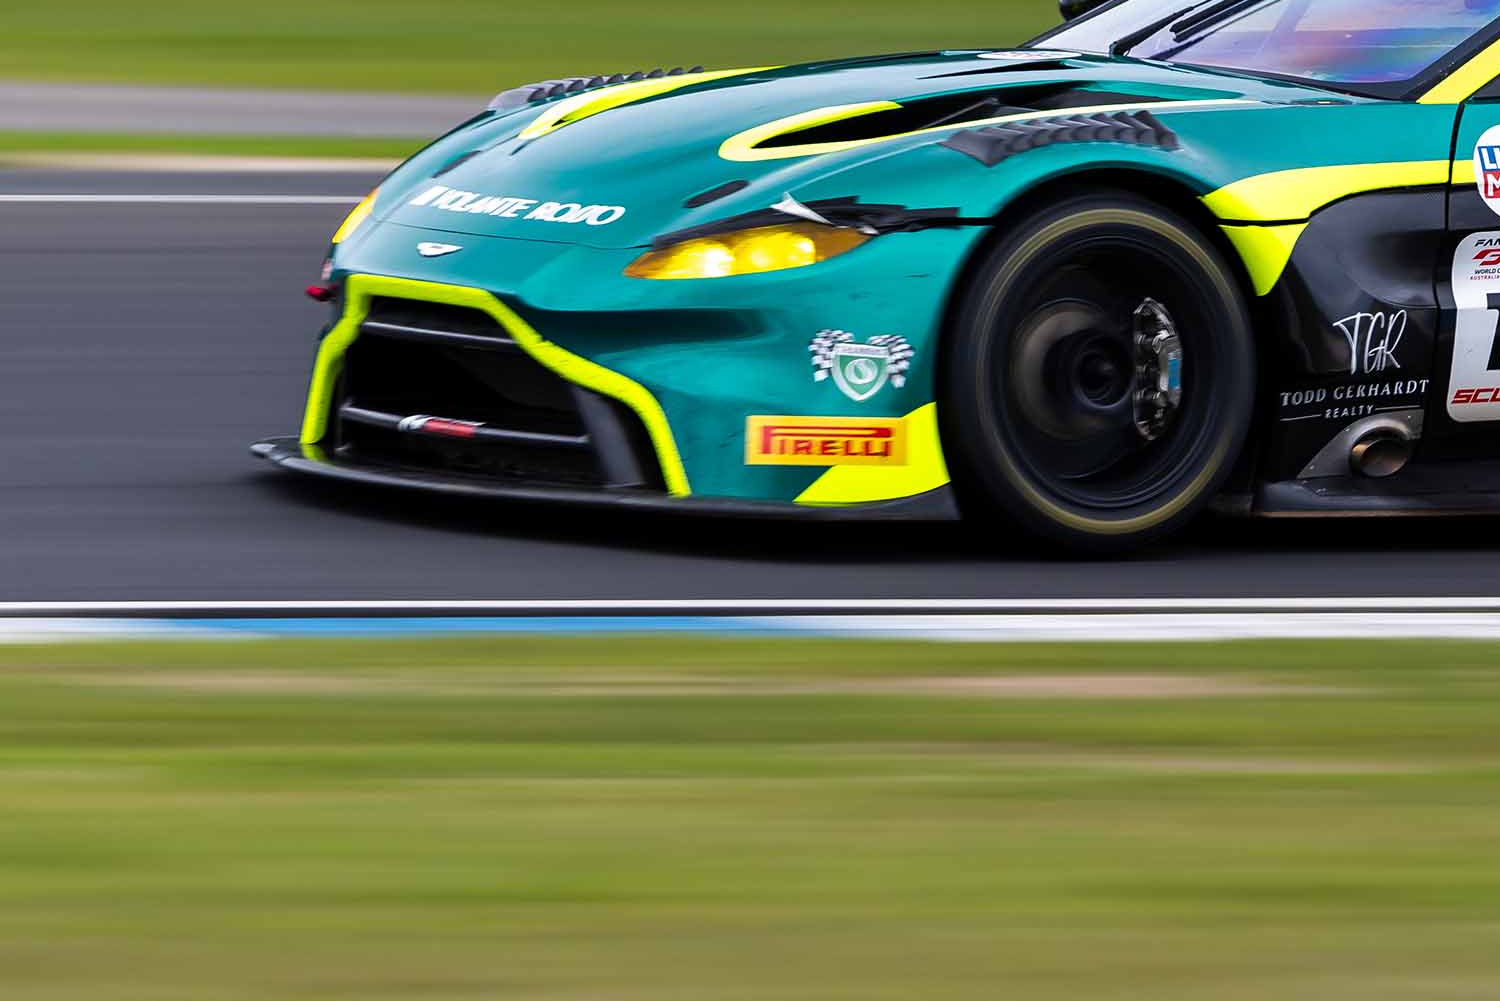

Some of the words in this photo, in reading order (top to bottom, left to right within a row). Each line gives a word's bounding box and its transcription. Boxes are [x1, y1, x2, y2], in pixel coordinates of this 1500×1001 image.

[1280, 388, 1327, 407] TODD
[1333, 380, 1430, 400] GERHARDT
[1325, 405, 1374, 419] REALTY
[760, 425, 894, 457] PIRELLI
